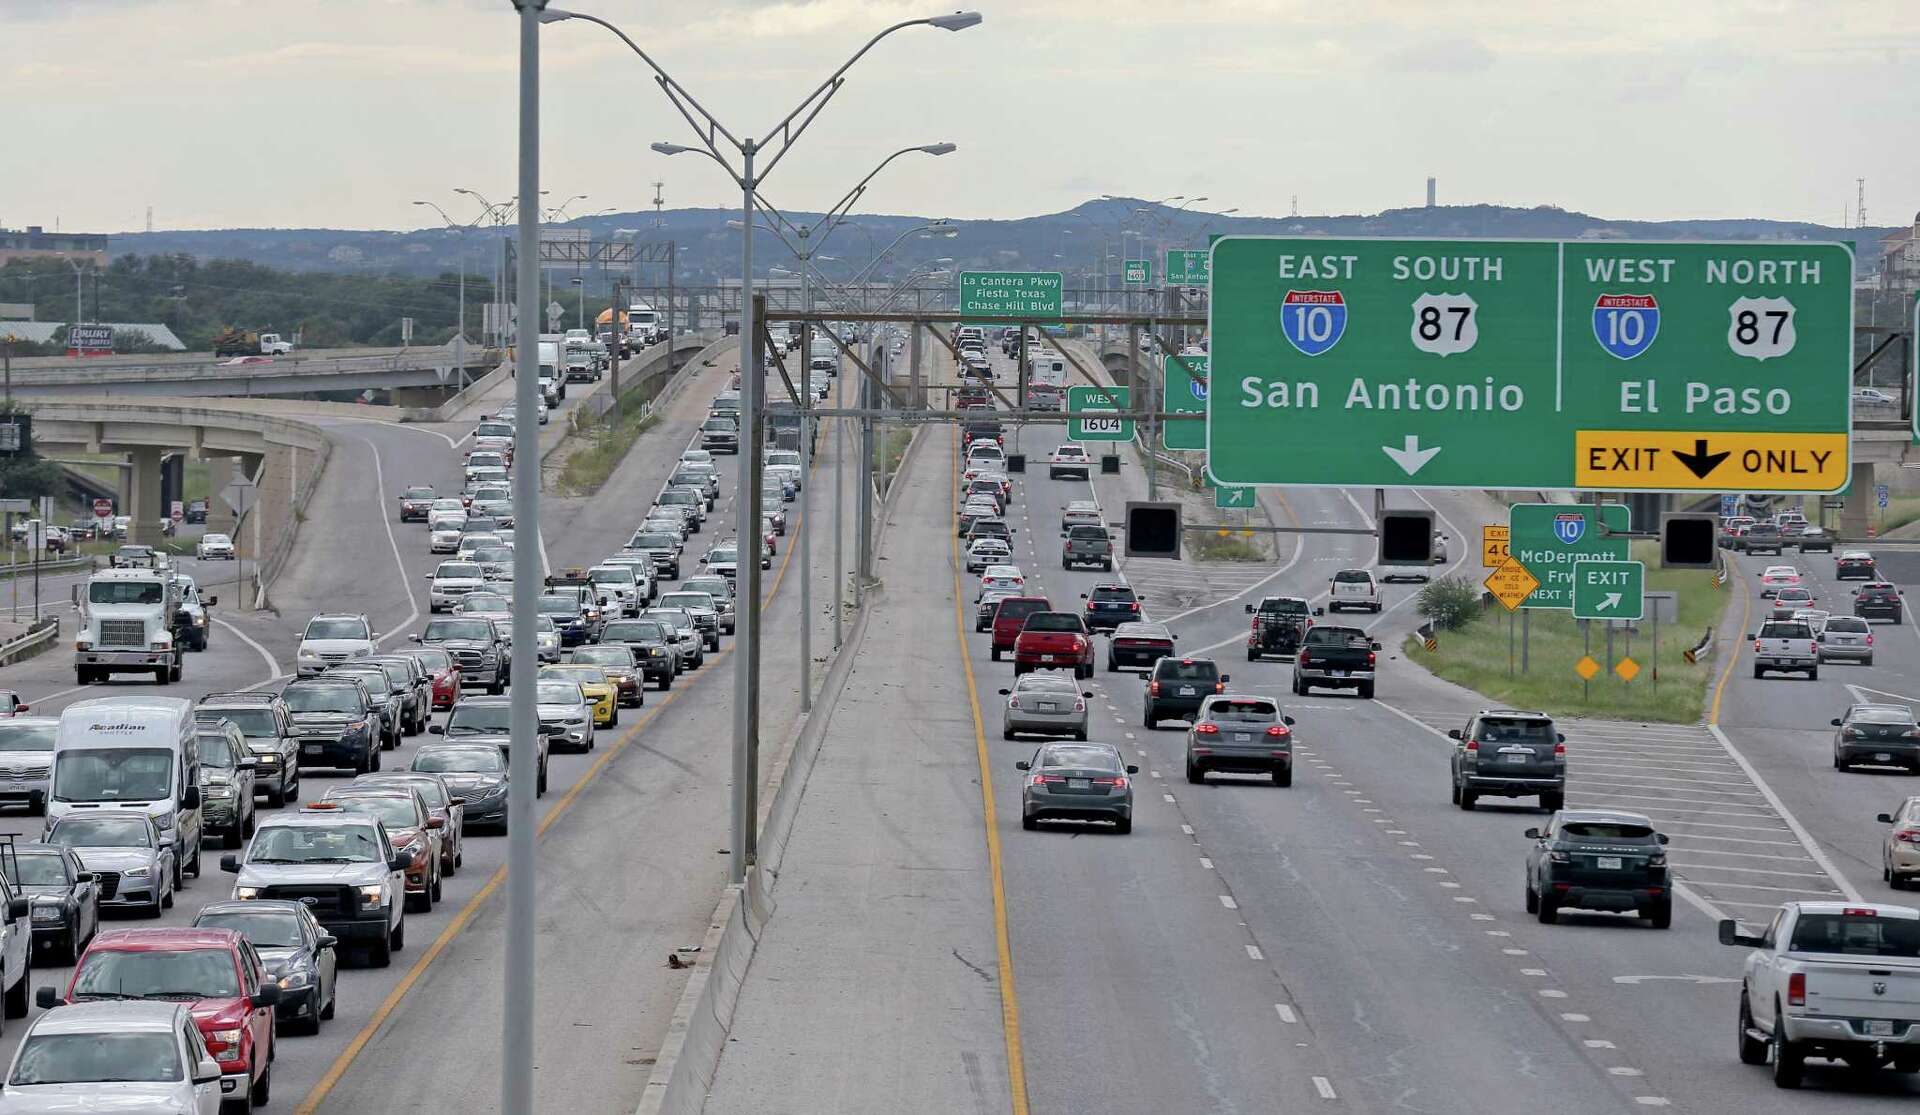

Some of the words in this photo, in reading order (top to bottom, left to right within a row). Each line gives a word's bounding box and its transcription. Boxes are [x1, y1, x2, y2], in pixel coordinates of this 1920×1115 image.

[1279, 255, 1358, 279] EAST
[1392, 256, 1503, 281] SOUTH
[1585, 258, 1676, 283] WEST
[1706, 260, 1821, 284] NORTH
[963, 277, 976, 285] La
[981, 277, 1024, 286] Cantera
[1031, 277, 1058, 288] Pkwy
[976, 289, 1009, 298] Fiesta
[1015, 289, 1046, 298] Texas
[1291, 294, 1337, 303] INTERSTATE
[967, 301, 1000, 310] Chase
[1006, 301, 1025, 310] Hill
[1031, 302, 1055, 311] Blvd
[1603, 298, 1649, 307] INTERSTATE
[1295, 307, 1333, 342] 10
[1418, 306, 1471, 342] 87
[1607, 310, 1645, 346] 10
[1735, 310, 1789, 345] 87
[1240, 376, 1318, 408] San
[1344, 377, 1524, 411] Antonio
[1620, 379, 1659, 414] El
[1686, 382, 1791, 415] Paso
[1084, 418, 1120, 431] 1604
[1589, 448, 1661, 471] EXIT
[1742, 450, 1832, 474] ONLY
[1560, 521, 1579, 538] 10
[1520, 550, 1616, 563] McDermott
[1587, 572, 1630, 585] EXIT
[1529, 590, 1562, 600] NEXT
